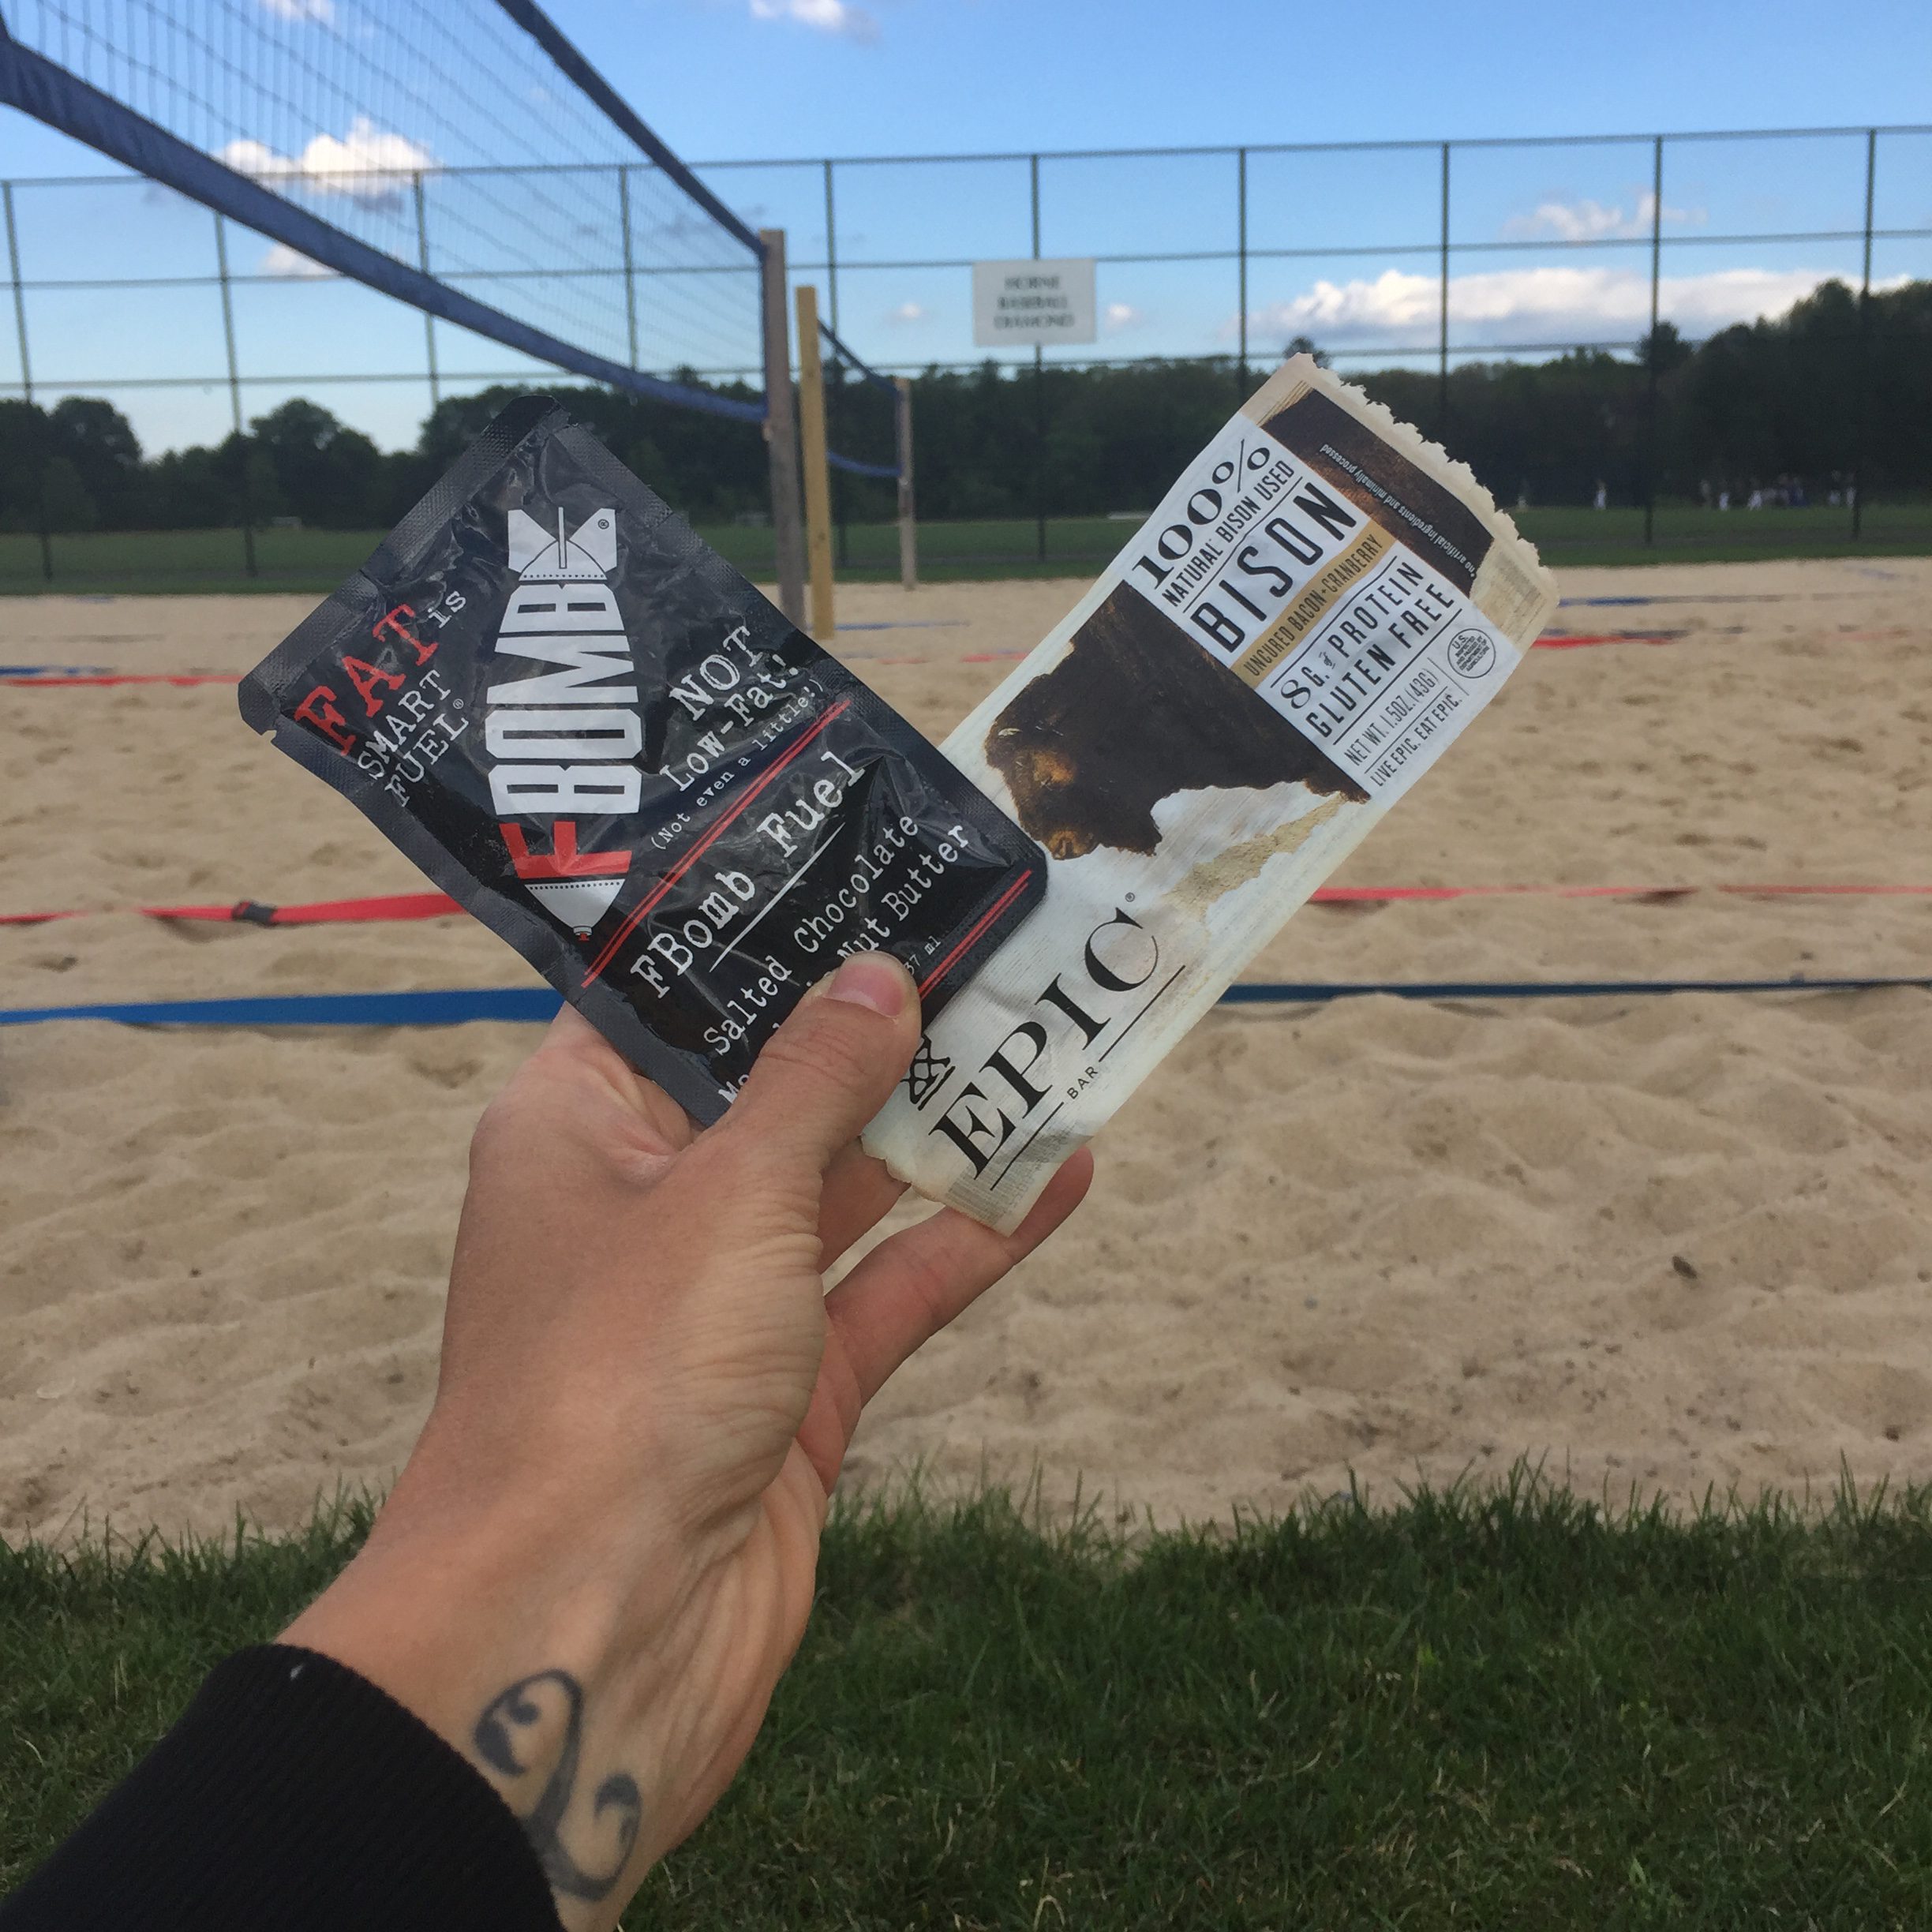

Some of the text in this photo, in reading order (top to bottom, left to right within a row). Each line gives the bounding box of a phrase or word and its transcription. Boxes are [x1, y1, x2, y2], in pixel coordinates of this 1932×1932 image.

[1215, 496, 1261, 543] BISON
[1253, 460, 1295, 502] USED
[1319, 444, 1357, 474] processed
[1354, 470, 1387, 500] minimally
[1384, 496, 1401, 510] and
[1132, 439, 1271, 590] 100%
[1398, 505, 1440, 541] ingredients
[1434, 534, 1467, 564] artificial
[1190, 482, 1357, 653] BISON
[1327, 562, 1424, 658] PROTEIN
[294, 590, 467, 757] FAT is
[668, 626, 763, 721] NOT
[1243, 625, 1295, 677] UNCURED
[1306, 583, 1455, 738] GLUTEN FREE
[358, 668, 452, 781] SMART
[651, 679, 824, 850] (Not even a little!)
[1344, 738, 1372, 766] NET
[1361, 722, 1390, 747] WT.
[1370, 694, 1462, 787] LIVE EPIC. EAT EPIC.
[630, 751, 866, 999] FBomb Fuel
[881, 824, 969, 922] Butter
[703, 955, 792, 1056] Salted
[793, 815, 919, 954] Chocolate
[924, 935, 942, 956] ml
[1067, 1065, 1099, 1101] BAR
